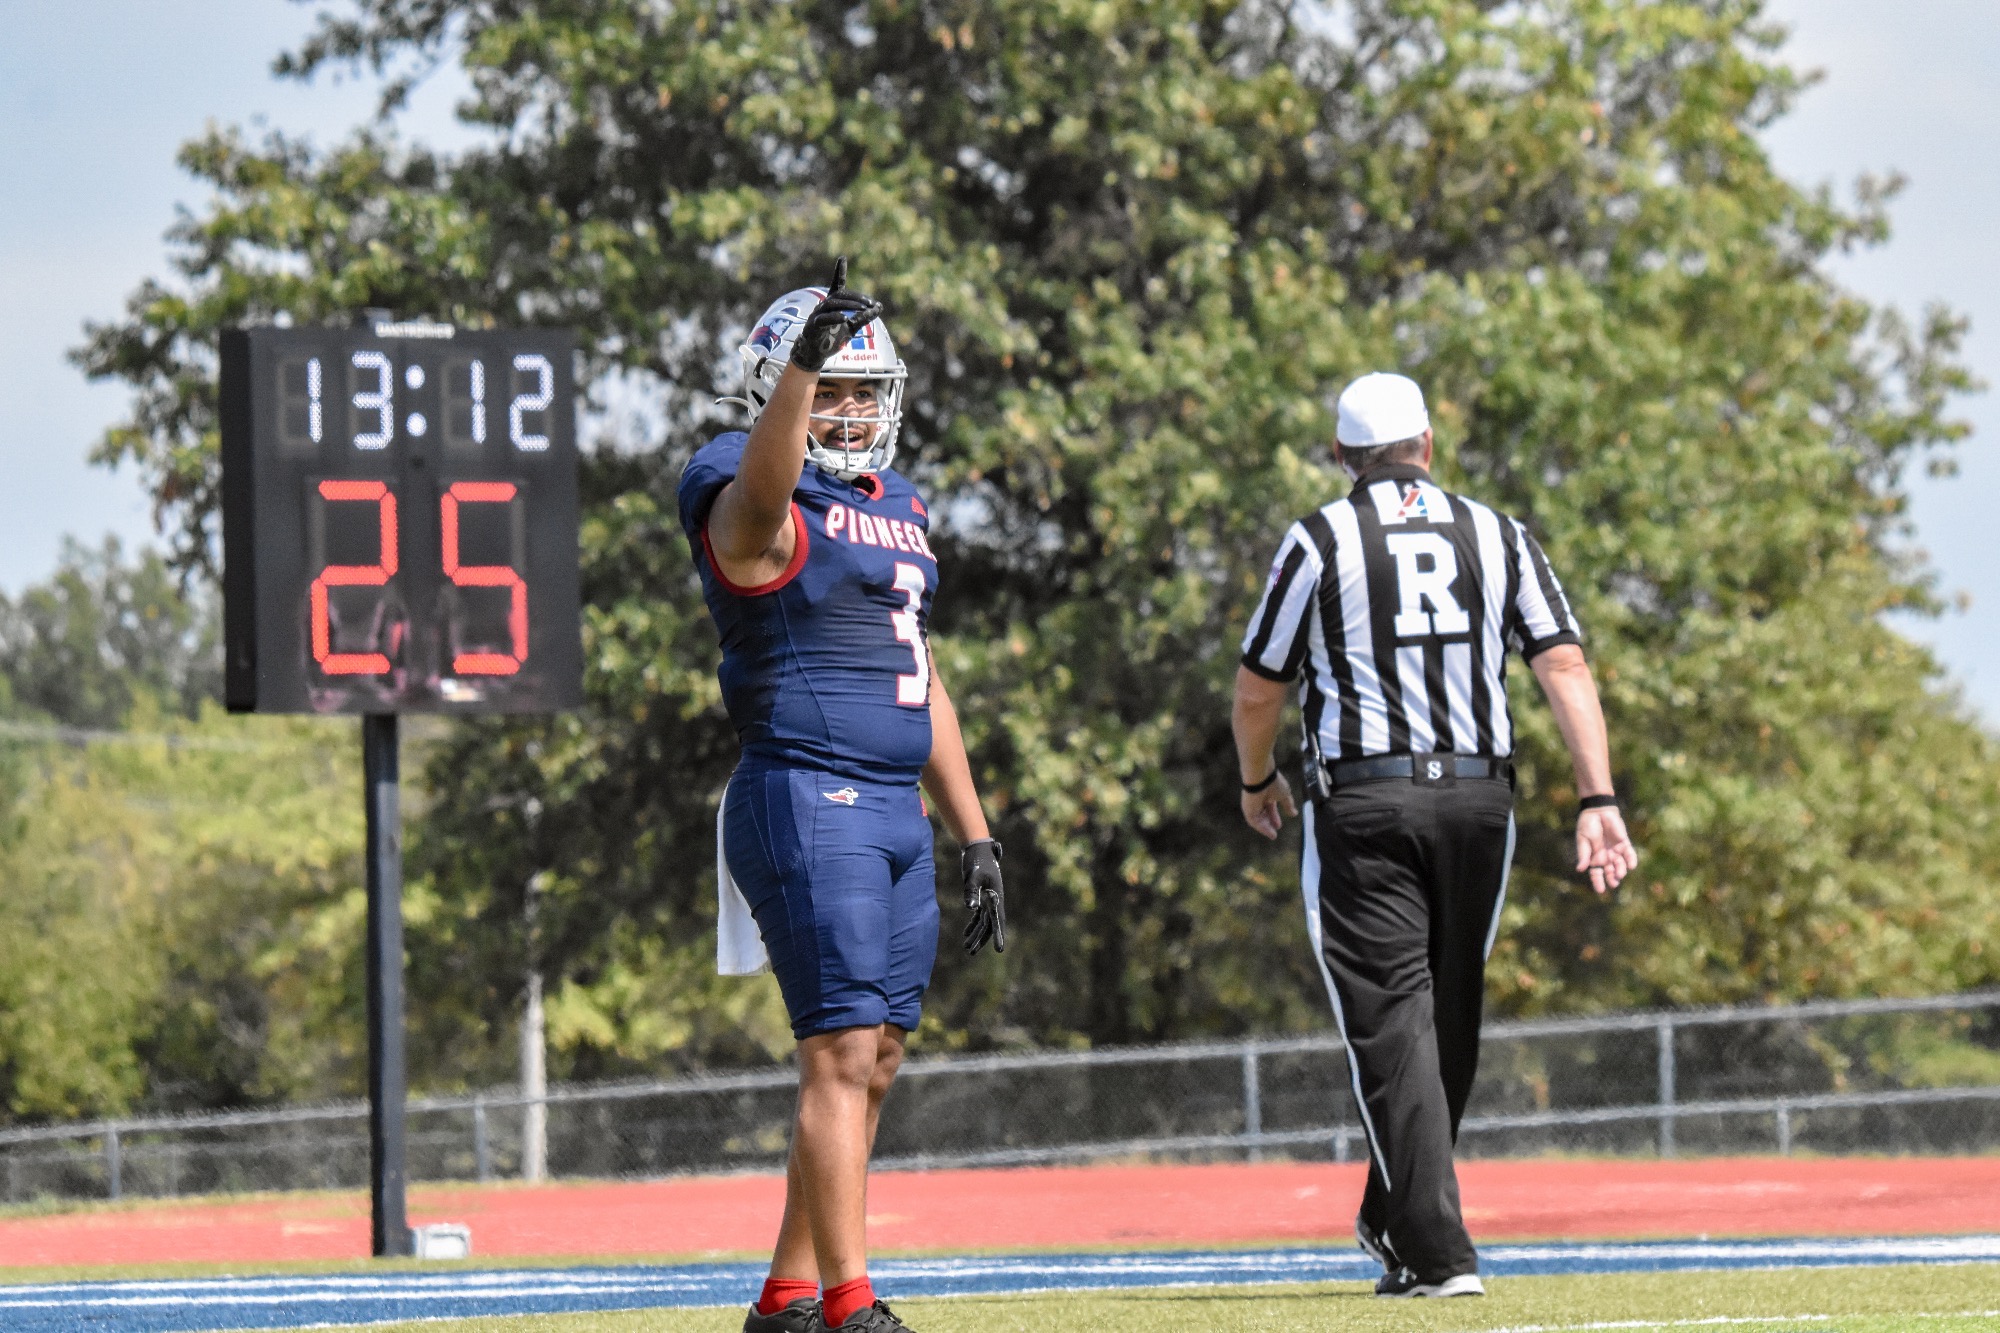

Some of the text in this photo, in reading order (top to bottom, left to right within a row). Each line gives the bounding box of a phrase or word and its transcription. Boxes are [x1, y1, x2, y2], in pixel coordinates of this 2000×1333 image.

[307, 351, 554, 451] 13:12
[310, 481, 529, 675] 25
[1386, 532, 1470, 637] R
[890, 561, 930, 706] 3
[1426, 760, 1443, 780] S
